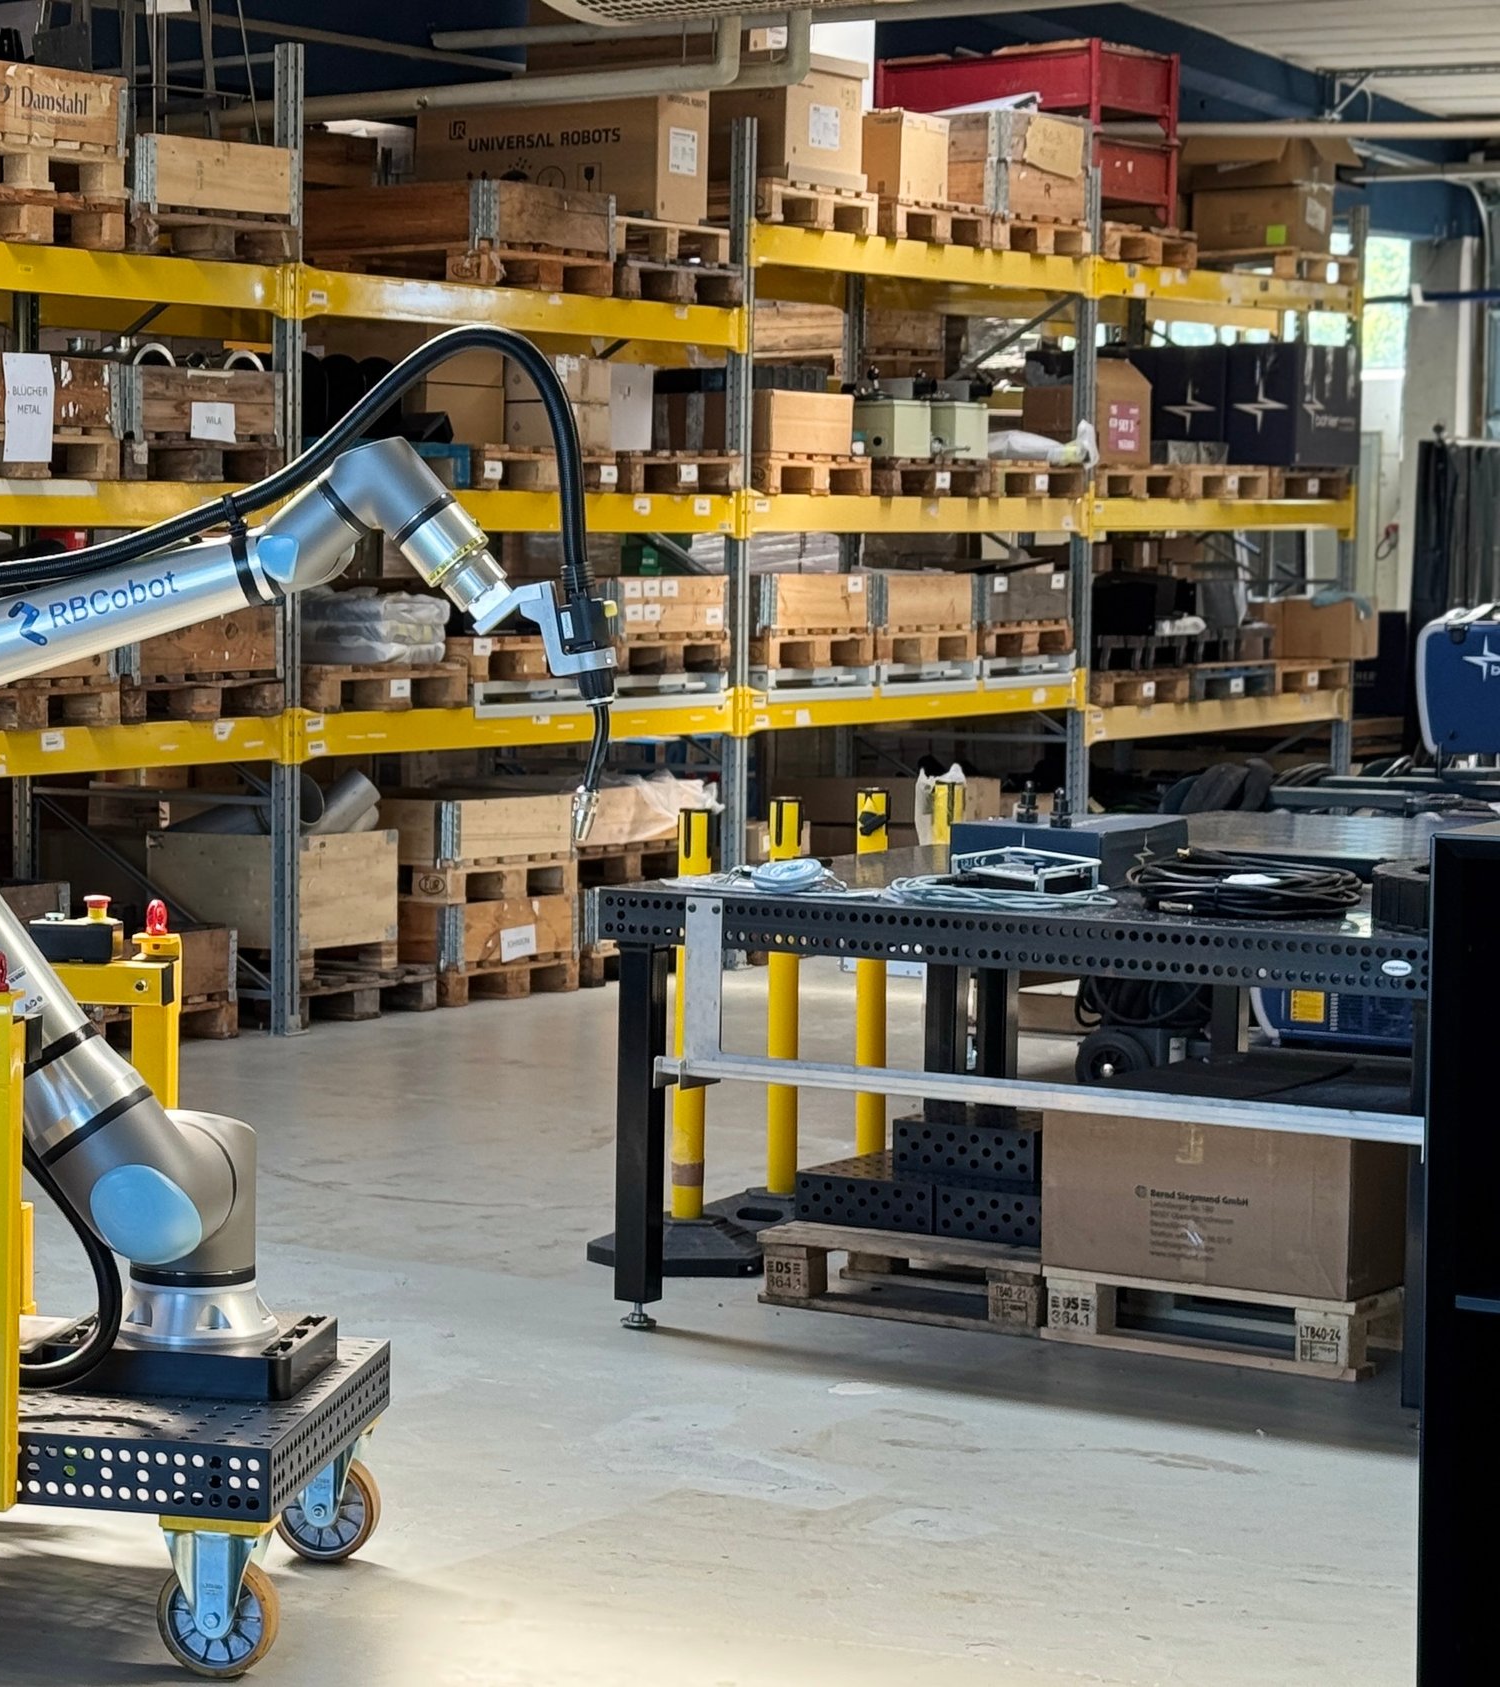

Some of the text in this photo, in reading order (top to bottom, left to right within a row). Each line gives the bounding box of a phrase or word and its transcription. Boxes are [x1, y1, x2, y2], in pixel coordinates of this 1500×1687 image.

[21, 86, 88, 115] Damstahl
[468, 127, 621, 152] UNIVERSAL ROBOTS
[12, 385, 49, 397] BLÜCHER
[17, 404, 42, 415] METAL
[48, 570, 180, 629] RBCobot
[1150, 1189, 1175, 1199] Bernd
[1221, 1196, 1249, 1207] GmbH
[1051, 1309, 1090, 1328] 364.1
